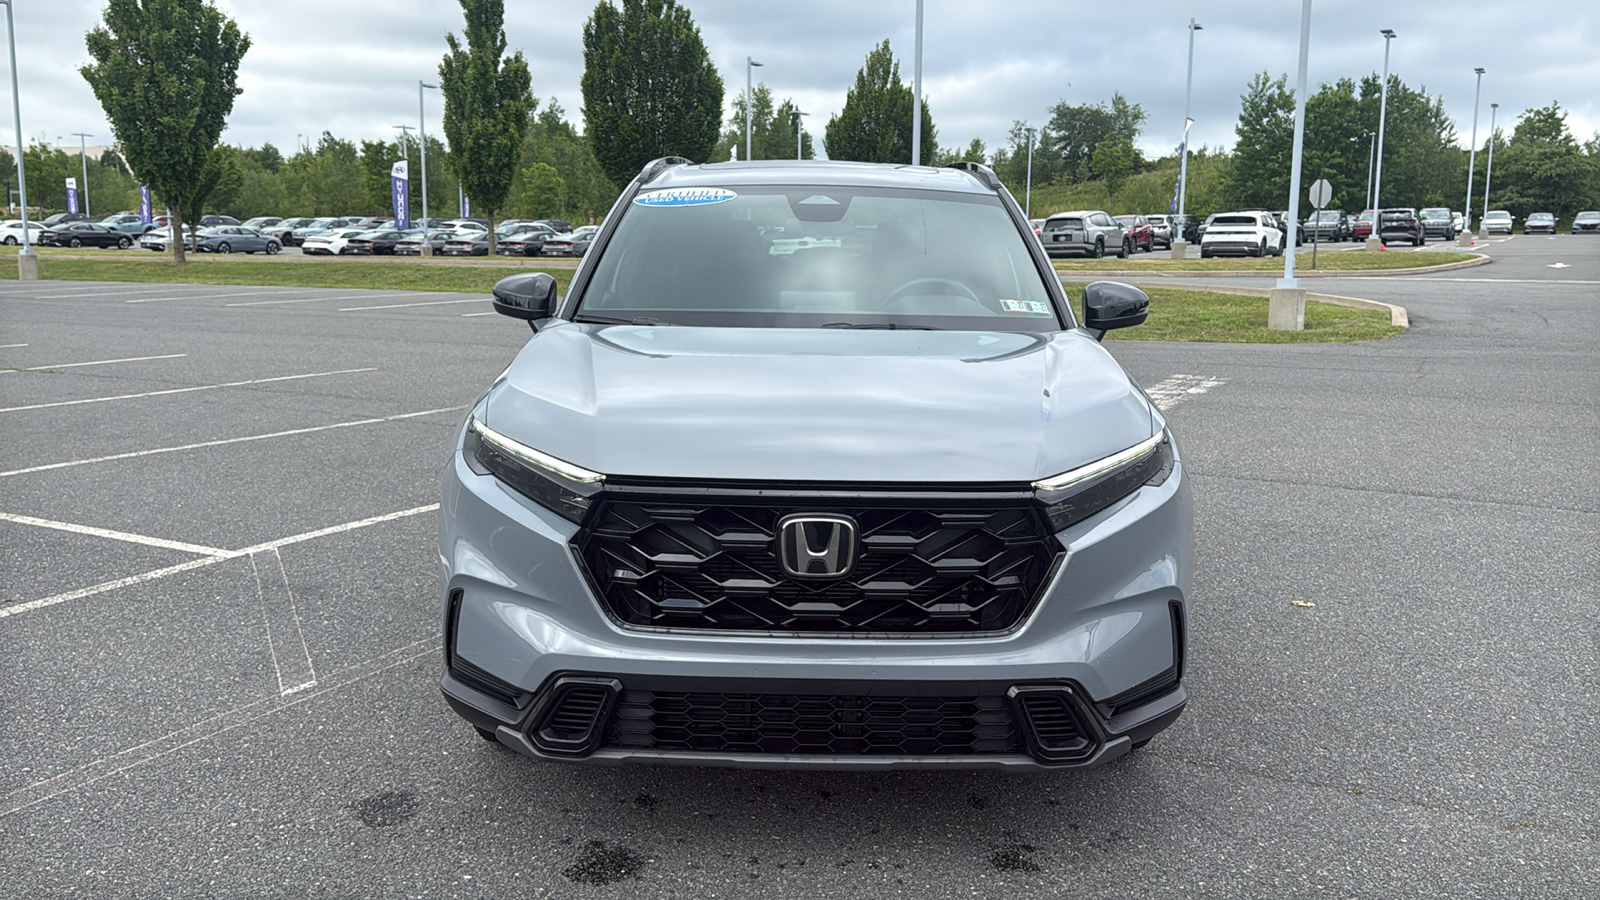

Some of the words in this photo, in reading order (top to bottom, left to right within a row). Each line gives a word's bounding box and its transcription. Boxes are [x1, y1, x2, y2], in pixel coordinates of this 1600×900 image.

[644, 196, 674, 204] USED
[676, 194, 724, 202] VEHICLE
[647, 189, 726, 199] CERTIFIED
[396, 180, 405, 227] HYUNDAI
